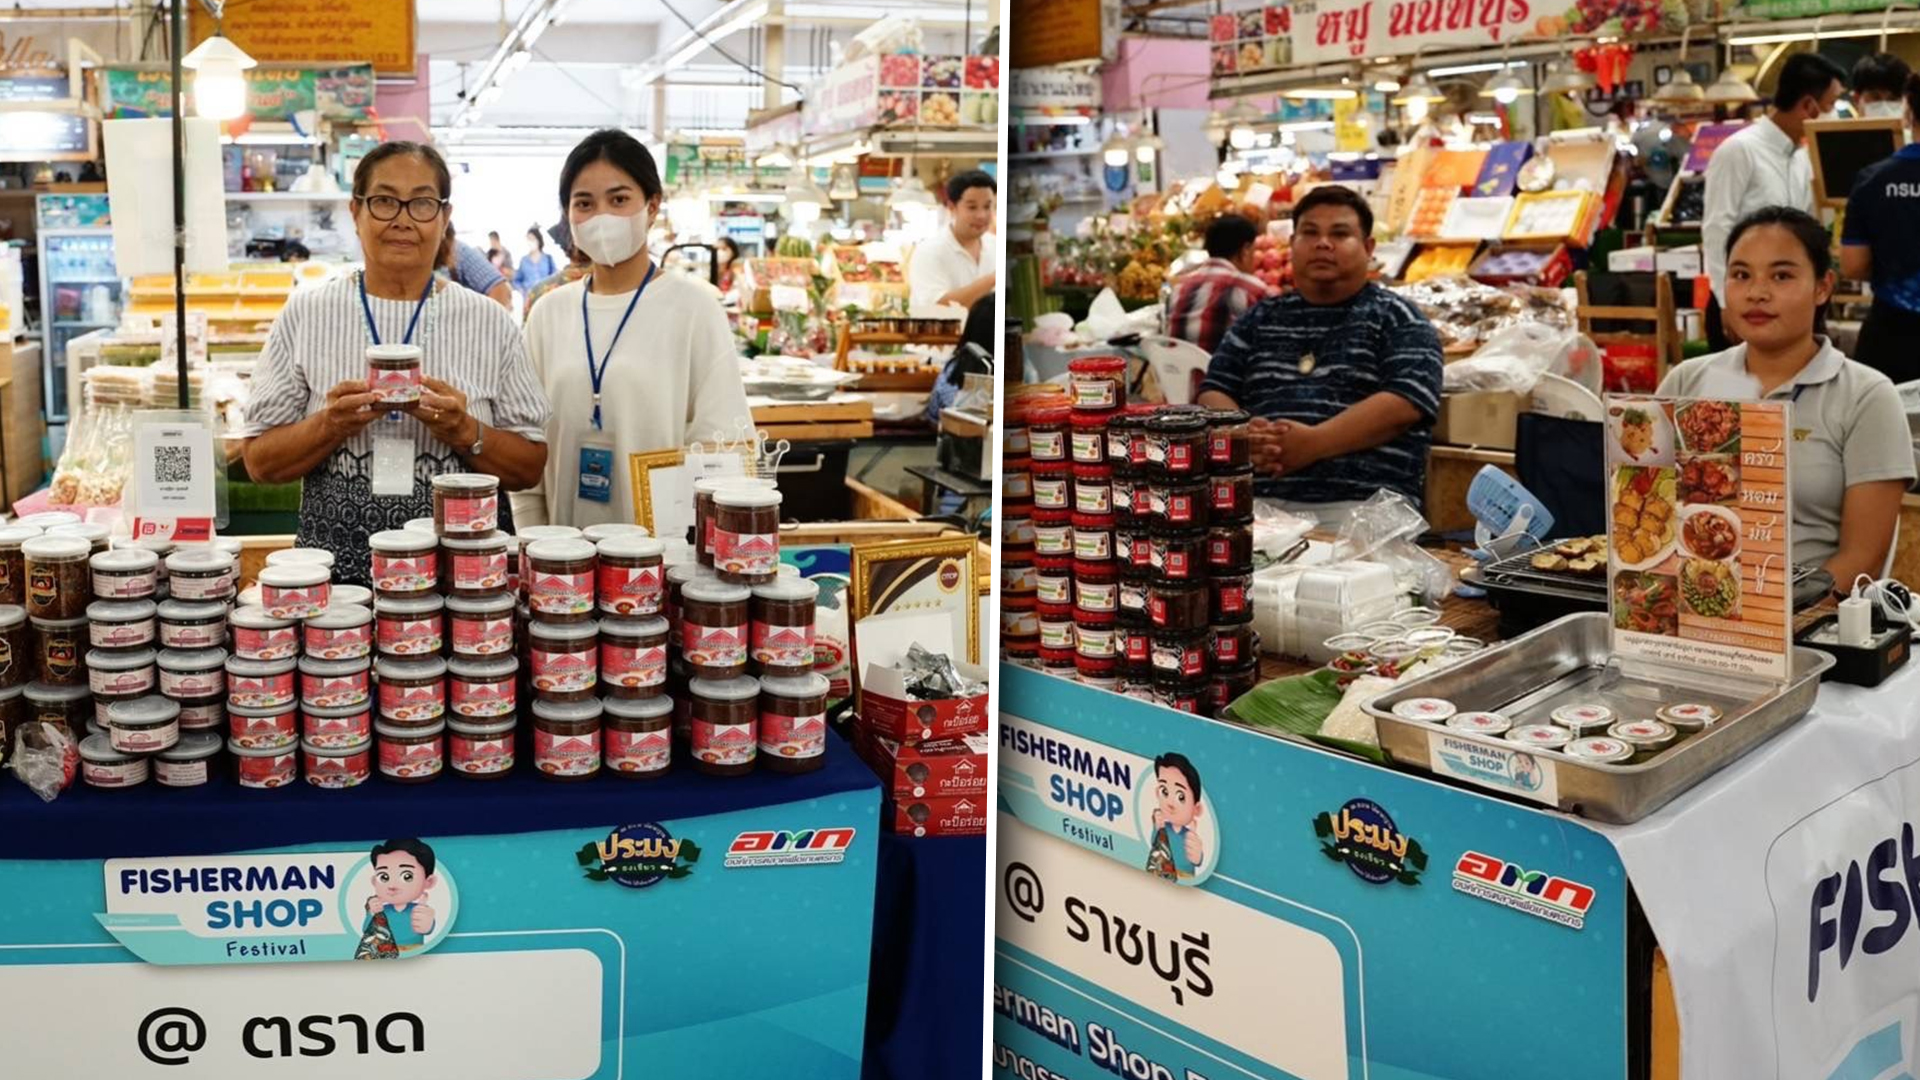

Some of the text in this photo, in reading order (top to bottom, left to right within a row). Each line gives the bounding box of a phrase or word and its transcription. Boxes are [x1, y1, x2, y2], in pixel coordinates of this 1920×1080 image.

[1316, 2, 1371, 56] หมู
[1000, 723, 1131, 790] FISHERMAN
[1443, 738, 1507, 761] FISHERMAN
[1469, 755, 1504, 772] SHOP
[1050, 774, 1124, 822] SHOP
[599, 832, 678, 861] ประมง
[1062, 818, 1114, 851] Festival
[1332, 808, 1408, 857] ประมง
[120, 864, 336, 895] FISHERMAN
[206, 898, 323, 930] SHOP
[226, 939, 306, 957] Festival
[1004, 861, 1213, 1006] @ ราชบุรี
[138, 1007, 425, 1065] @ ตราด
